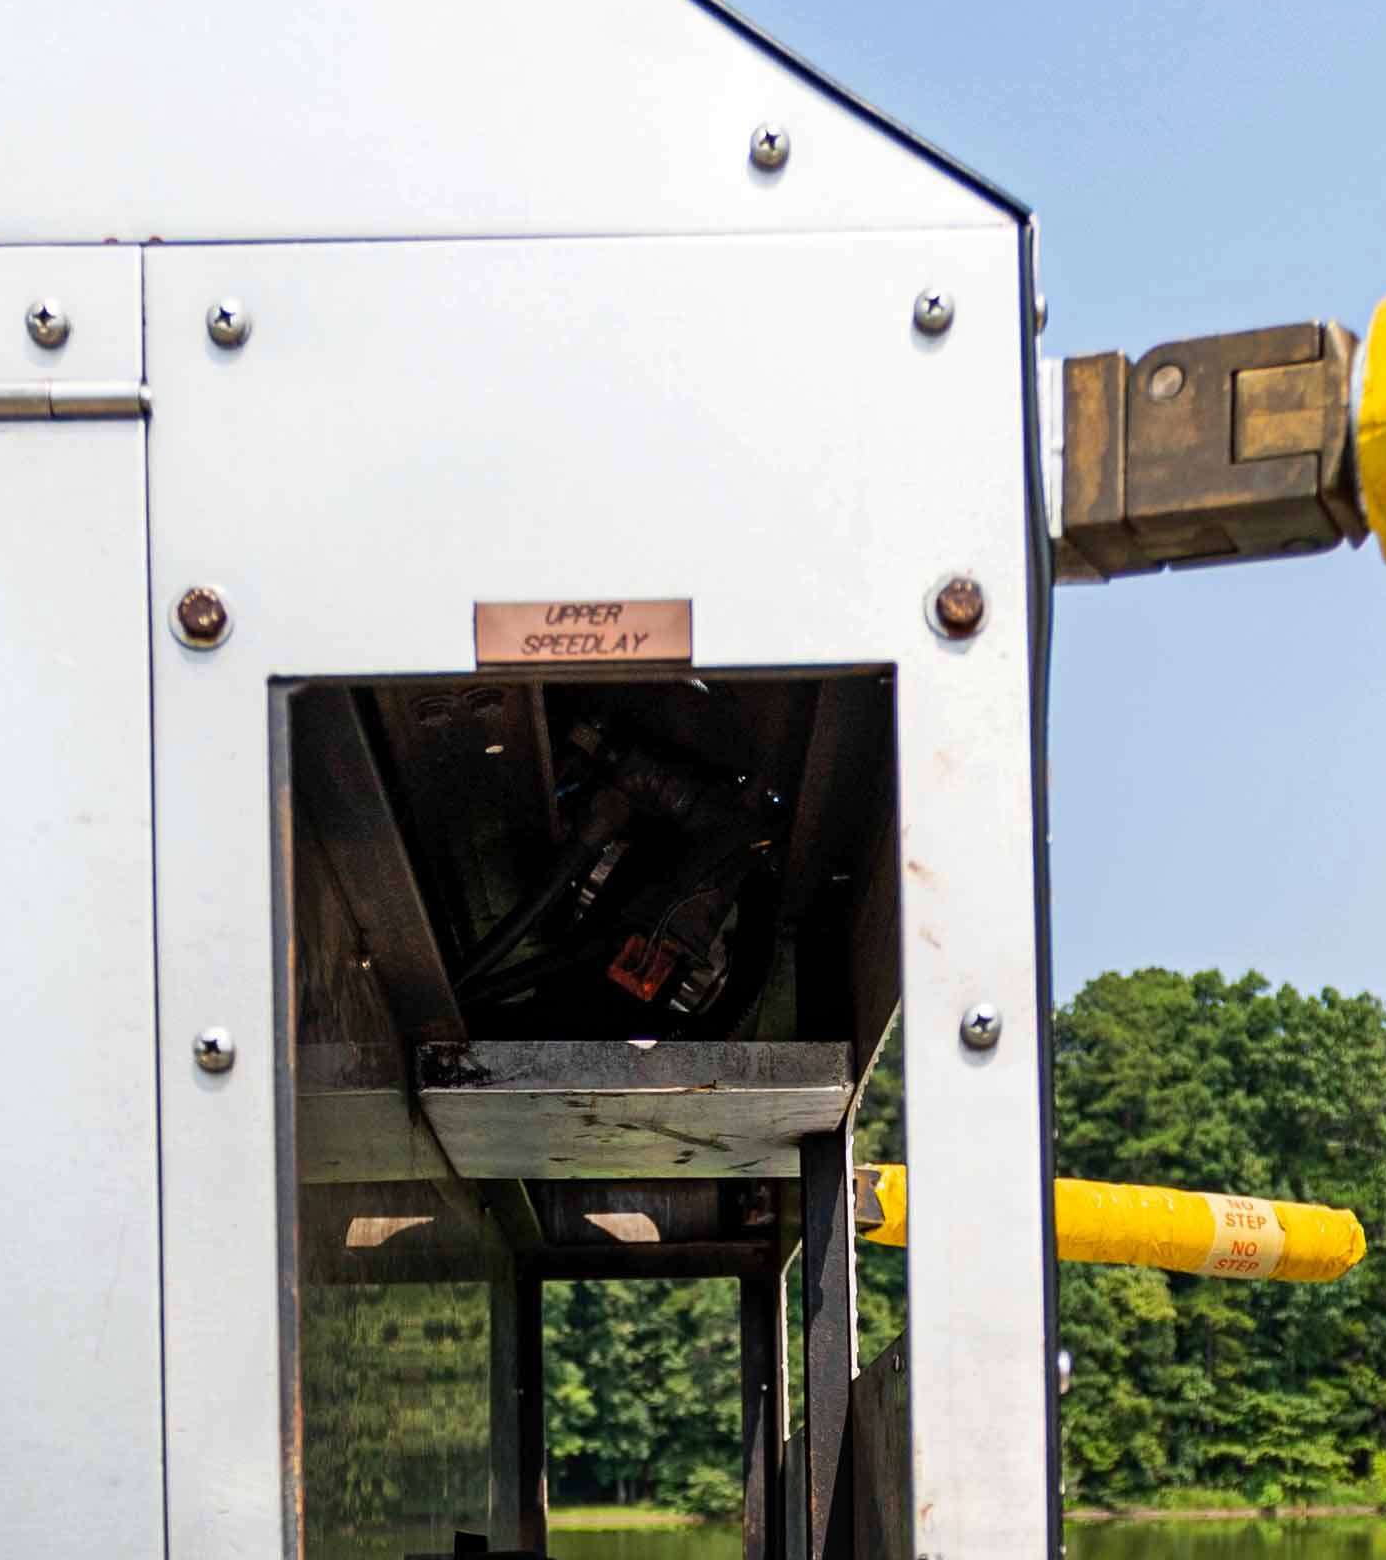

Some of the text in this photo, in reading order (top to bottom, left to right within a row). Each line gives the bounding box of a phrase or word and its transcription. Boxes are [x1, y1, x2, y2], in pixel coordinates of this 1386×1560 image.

[544, 603, 624, 626] UPPER
[521, 632, 649, 656] SPEEDLAY
[1227, 1199, 1254, 1211] NO
[1225, 1213, 1267, 1230] STEP
[1231, 1241, 1258, 1257] NO
[1214, 1258, 1261, 1273] STEP
